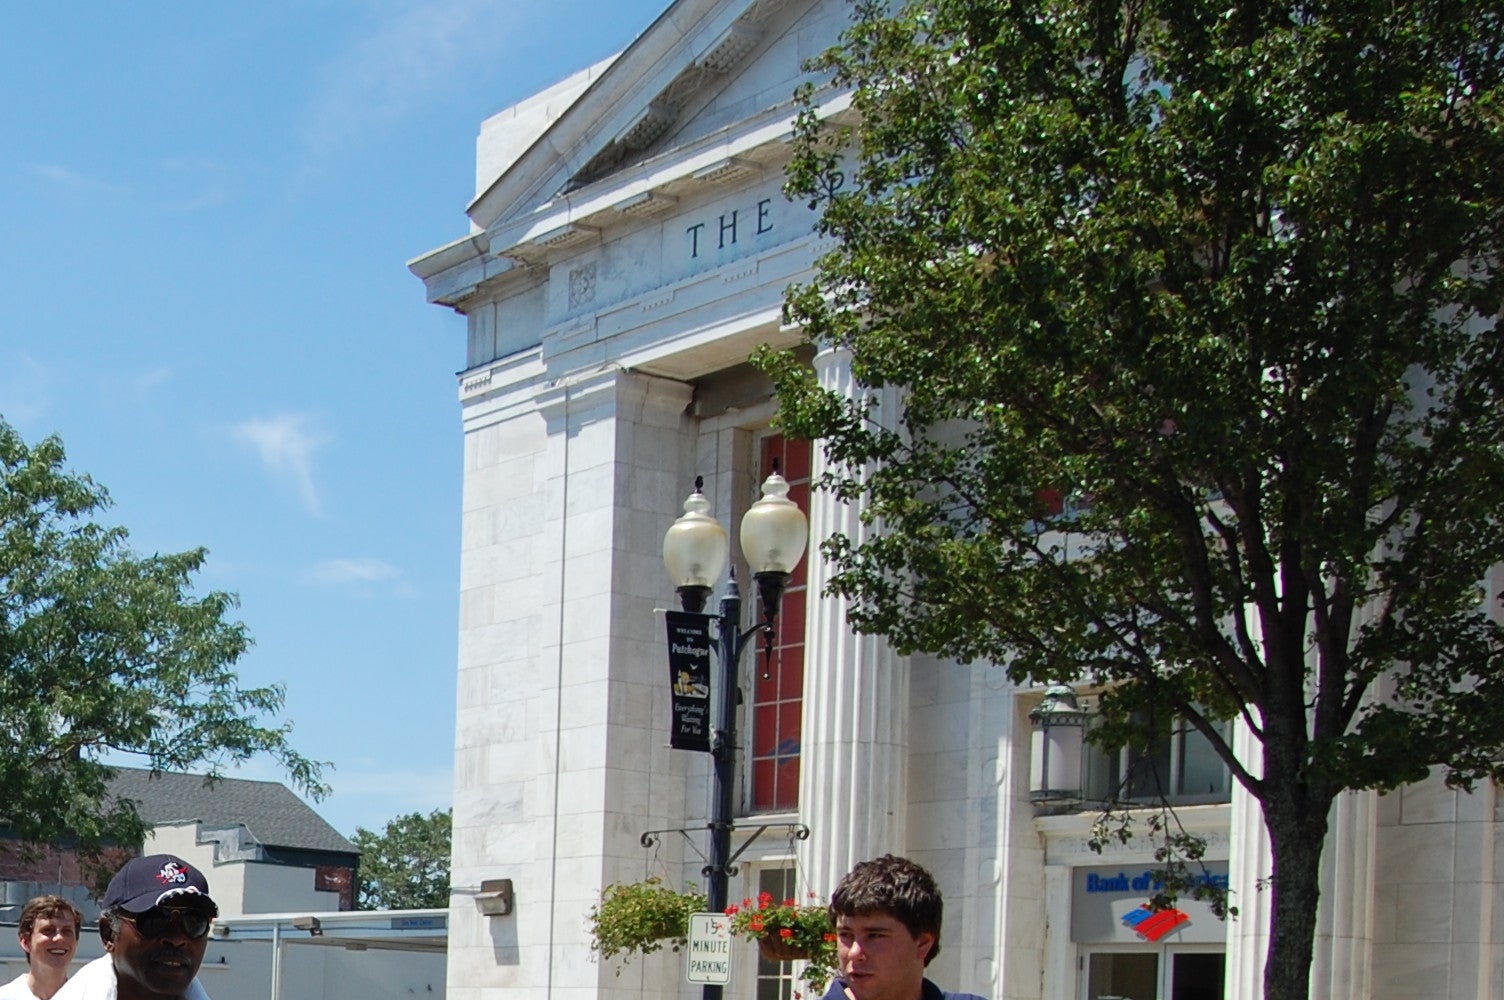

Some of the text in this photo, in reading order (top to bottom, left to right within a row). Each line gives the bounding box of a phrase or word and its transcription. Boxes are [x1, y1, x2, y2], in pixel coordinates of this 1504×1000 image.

[686, 197, 775, 259] THE
[1086, 870, 1130, 893] Bank
[1131, 869, 1153, 891] of
[692, 940, 727, 953] MINUTE
[691, 960, 727, 973] PARKING
